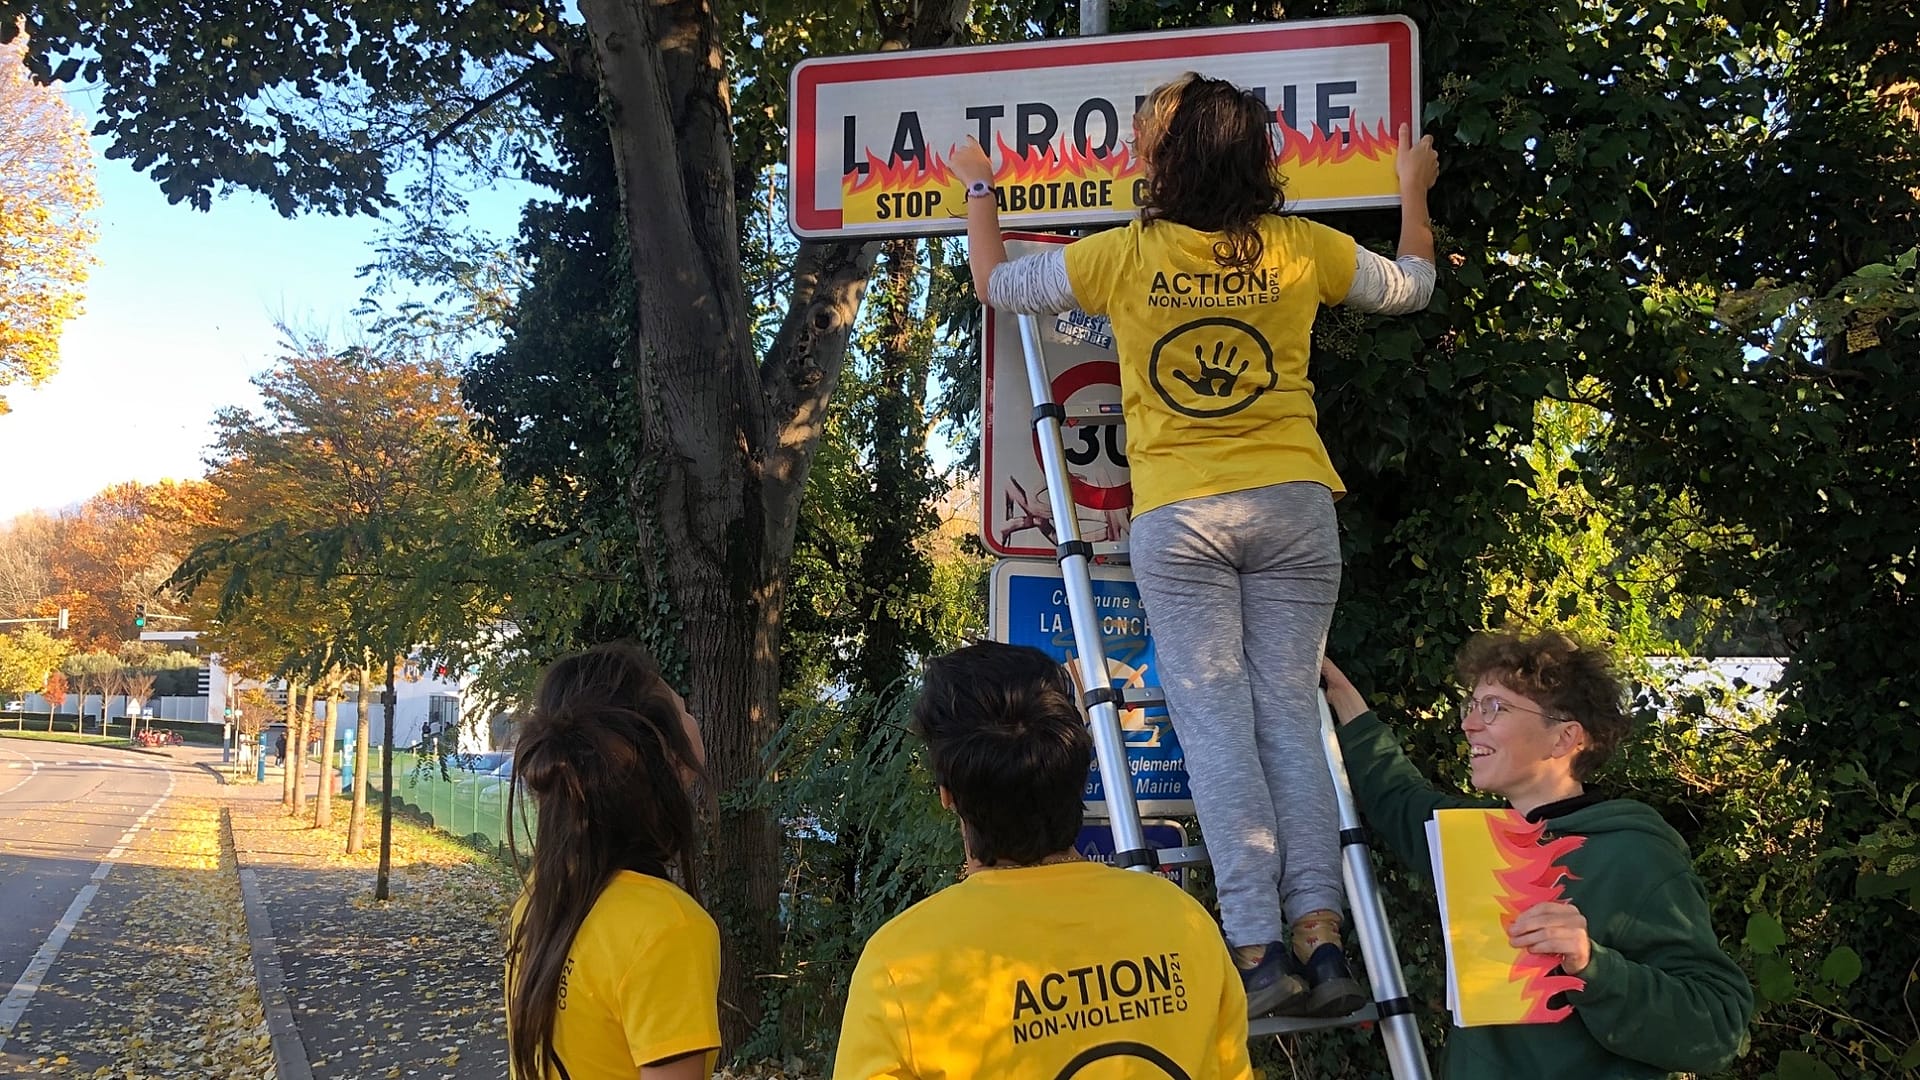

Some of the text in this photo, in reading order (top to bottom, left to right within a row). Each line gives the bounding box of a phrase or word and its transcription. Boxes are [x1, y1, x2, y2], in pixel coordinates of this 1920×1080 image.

[843, 110, 928, 175] LA
[876, 190, 942, 220] STOP
[965, 179, 1113, 212] ABOTAGE
[1148, 292, 1268, 308] NON-VIOLENTE
[1150, 268, 1268, 295] ACTION
[1269, 266, 1280, 303] COP21
[1040, 612, 1064, 633] LA
[1135, 778, 1181, 794] Mairie
[557, 957, 575, 1011] COP21
[1013, 954, 1172, 1020] ACTION
[1169, 952, 1188, 1011] COP21
[1013, 995, 1174, 1044] NON-VIOLENTE
